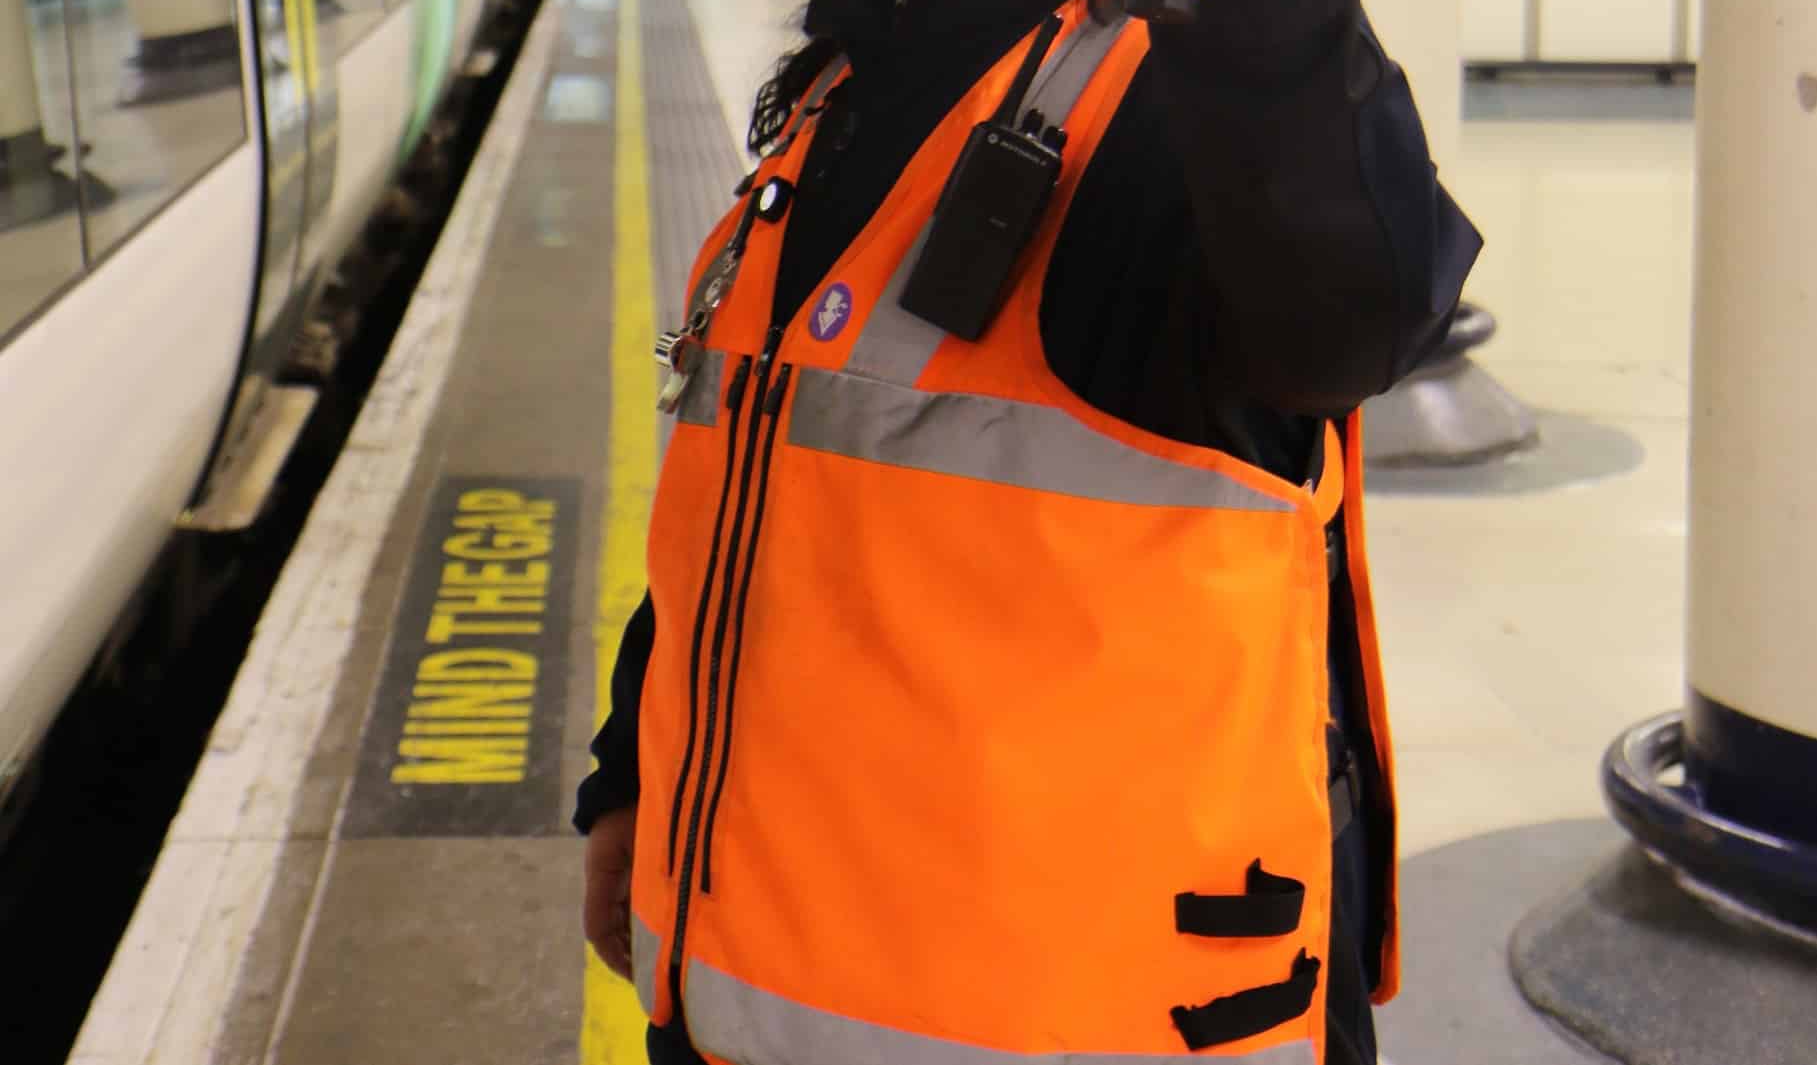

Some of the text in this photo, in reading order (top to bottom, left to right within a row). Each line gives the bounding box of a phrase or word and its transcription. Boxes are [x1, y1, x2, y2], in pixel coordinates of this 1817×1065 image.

[391, 488, 557, 784] MIND THE GAP
